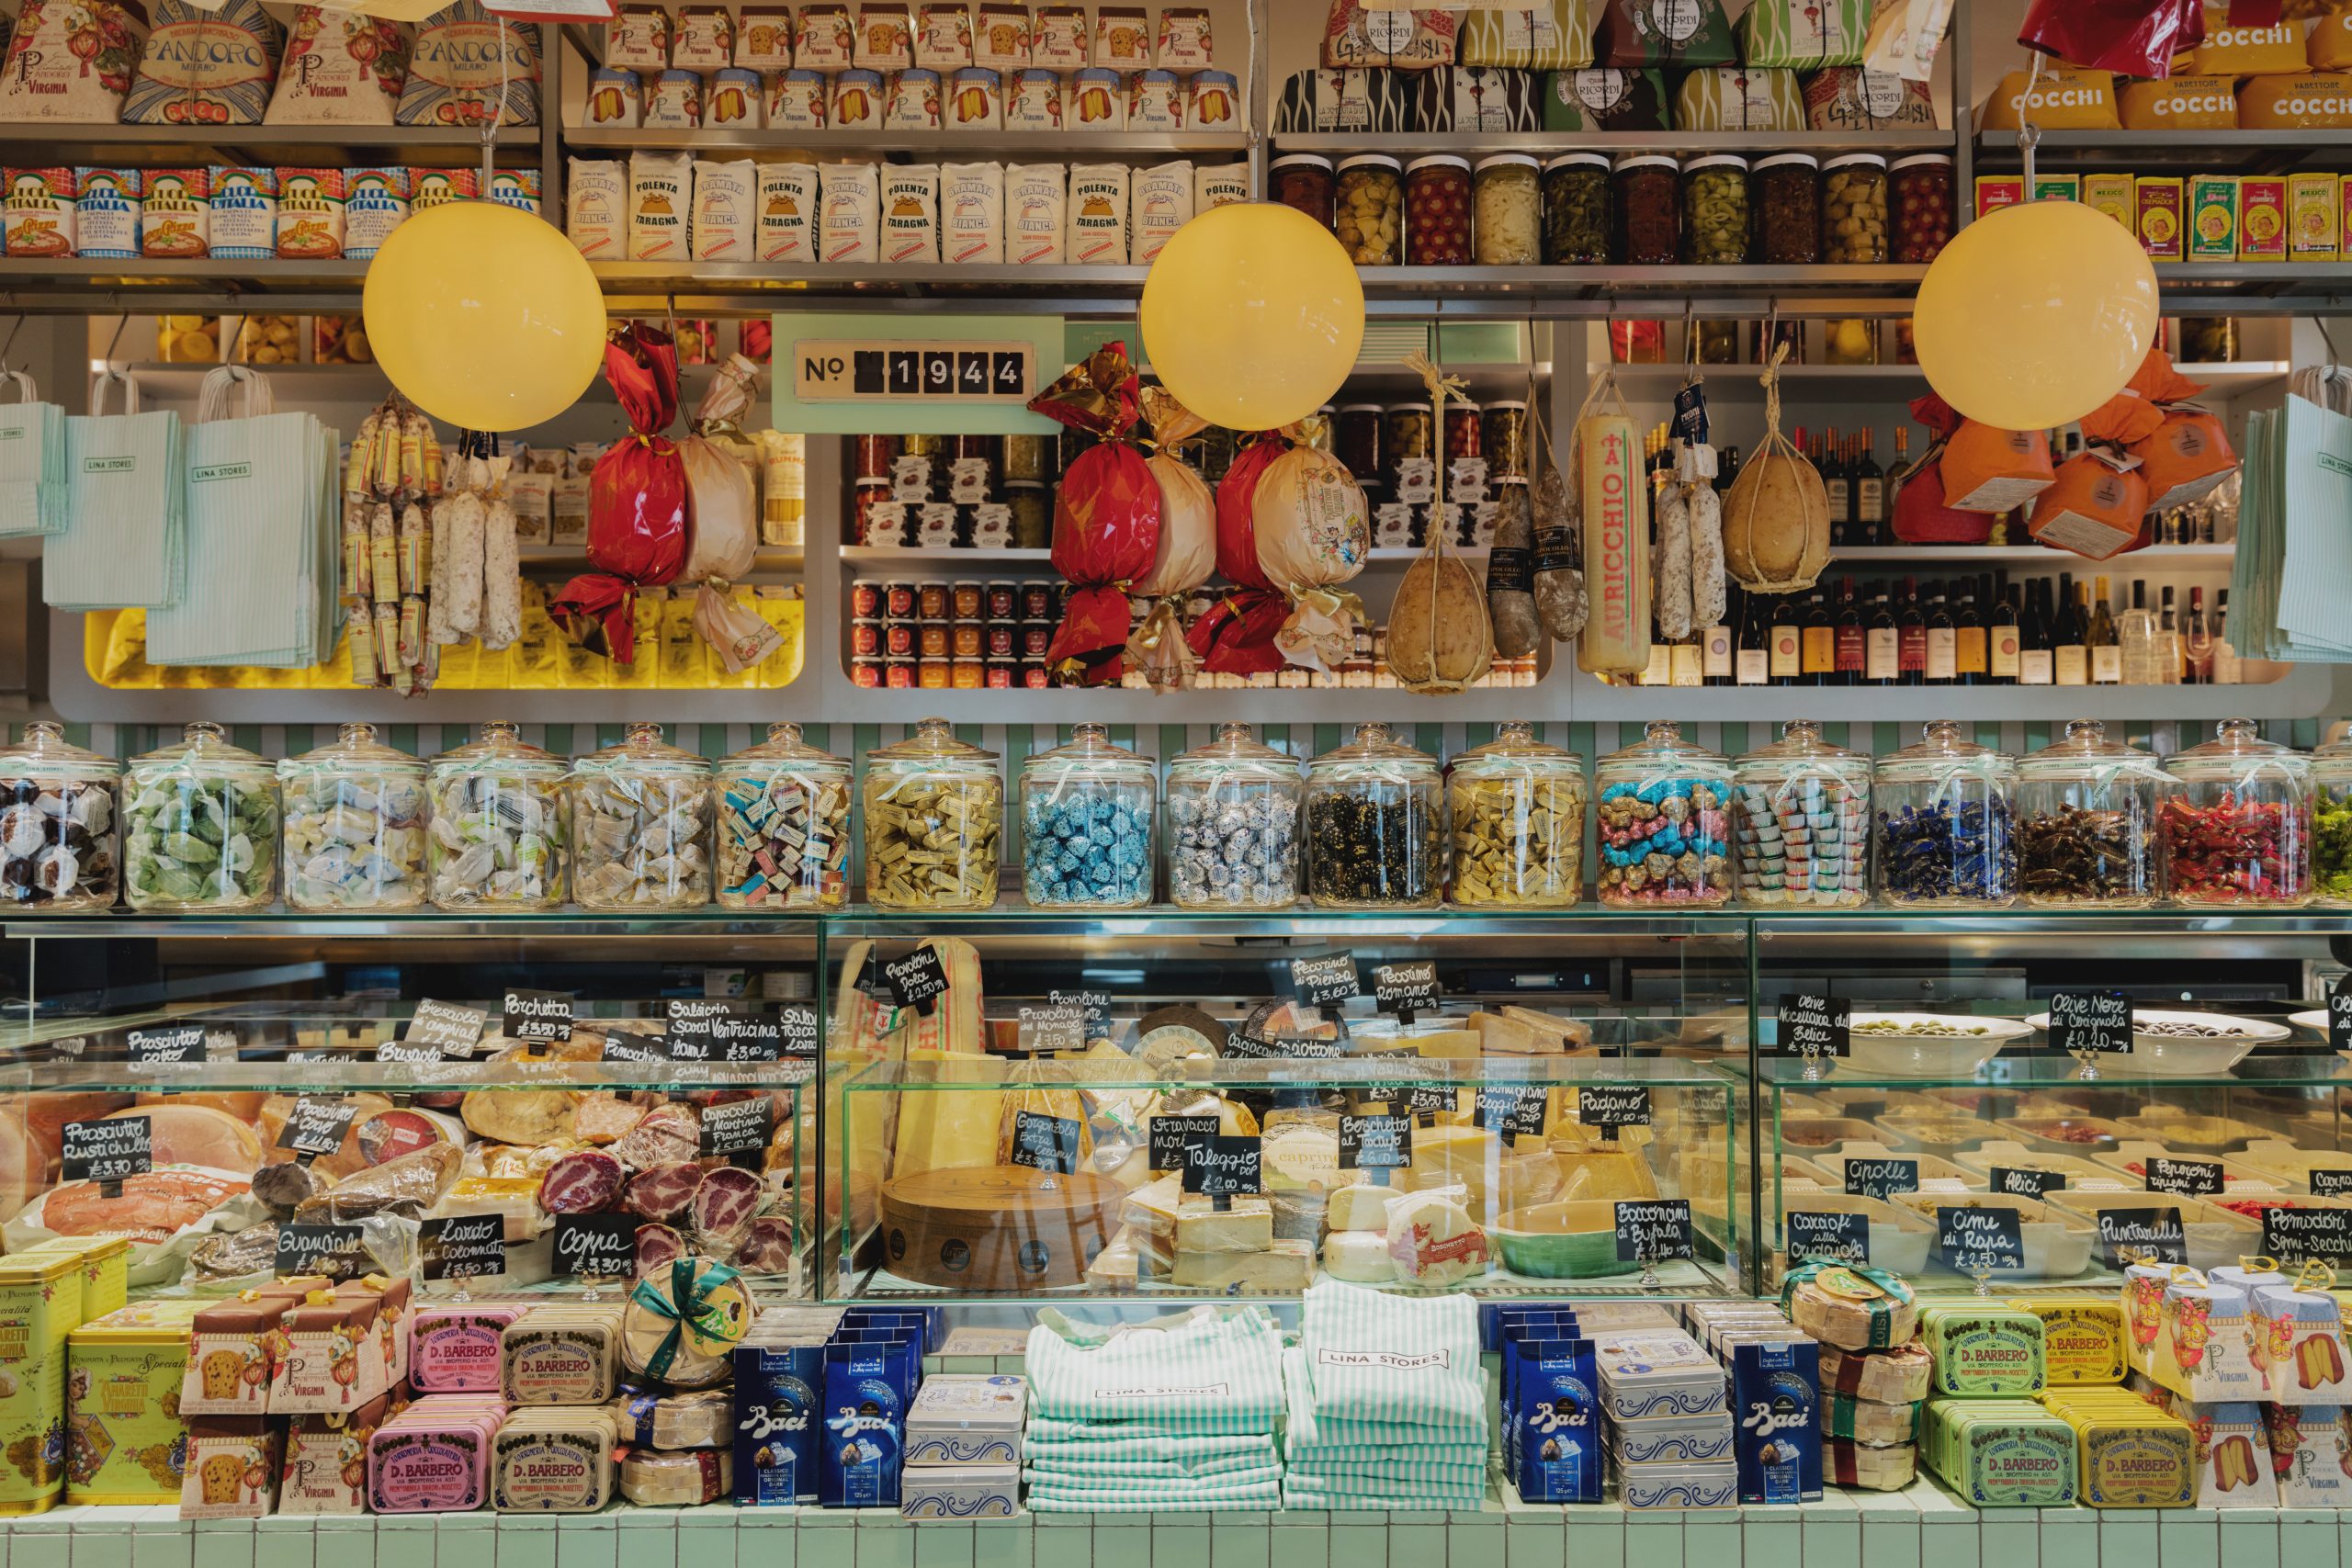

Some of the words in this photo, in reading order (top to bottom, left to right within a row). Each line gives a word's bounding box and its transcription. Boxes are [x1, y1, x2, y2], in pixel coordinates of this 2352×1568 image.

[1370, 28, 1409, 38] RICORDI
[2200, 28, 2292, 50] COCCHI
[142, 39, 263, 68] PANDORO
[414, 39, 533, 67] PANDORO
[453, 62, 487, 72] MILANO
[28, 82, 68, 95] VIRGINIA
[1860, 92, 1901, 103] RICORDI
[2010, 88, 2103, 110] COCCHI
[636, 180, 678, 195] POLENTA
[763, 183, 803, 196] POLENTA
[888, 183, 929, 196] POLENTA
[1078, 184, 1118, 197] POLENTA
[1205, 184, 1247, 197] POLENTA
[2096, 188, 2124, 197] MEXICO
[2300, 188, 2328, 197] MEXICO
[635, 215, 679, 228] TARAGNA
[762, 217, 804, 228] TARAGNA
[887, 217, 930, 229] TARAGNA
[1077, 217, 1119, 229] TARAGNA
[897, 359, 1018, 385] 1944
[88, 461, 107, 469] LINA
[108, 459, 132, 468] STORES
[2322, 456, 2335, 467] LINA
[196, 468, 216, 479] LINA
[219, 465, 248, 476] STORES
[1601, 473, 1625, 642] AURICCHIO
[886, 949, 936, 978] Provolone
[1292, 953, 1351, 976] Pecorino
[899, 971, 929, 993] Dolce
[1295, 976, 1306, 987] di
[1306, 969, 1356, 987] Pienza
[1377, 964, 1432, 985] Pecorino
[1376, 982, 1435, 1001] Romano
[504, 993, 574, 1020] Porchetta
[1798, 995, 1826, 1011] Olive
[2052, 993, 2089, 1013] Olive
[1020, 1007, 1084, 1022] Provolone
[1779, 1006, 1832, 1028] Nocellara
[1834, 1013, 1850, 1029] del
[2050, 1014, 2064, 1027] di
[711, 1016, 781, 1040] Ventricina
[1792, 1025, 1832, 1043] Belice
[127, 1029, 202, 1052] Prosciutto
[701, 1099, 769, 1121] Capocollo
[1476, 1095, 1543, 1115] Reggiano
[1579, 1091, 1646, 1111] Padano
[701, 1122, 711, 1134] di
[713, 1113, 765, 1132] Martina
[1016, 1113, 1077, 1140] Gorgonzola
[1341, 1115, 1410, 1134] Boschetto
[1520, 1112, 1542, 1123] DOP
[64, 1118, 145, 1142] Prosciutto
[713, 1126, 760, 1144] Franca
[1019, 1131, 1052, 1145] Extra
[62, 1136, 152, 1159] Rustichello
[1340, 1134, 1356, 1146] al
[1356, 1133, 1403, 1152] Tartufo
[1185, 1144, 1261, 1172] Taleggio
[1239, 1165, 1259, 1177] DOP
[1849, 1160, 1910, 1181] Cipolle
[2156, 1158, 2216, 1179] Peperoni
[2005, 1170, 2042, 1193] Alici
[1617, 1202, 1689, 1223] Bocconcini
[1952, 1210, 2000, 1231] Cime
[2268, 1208, 2348, 1231] Pomodori
[437, 1218, 497, 1244] Lardo
[1793, 1212, 1852, 1234] Carciofi
[2100, 1215, 2183, 1242] Puntarelle
[277, 1230, 361, 1255] Guanciale
[558, 1226, 634, 1255] Coppa
[1617, 1225, 1629, 1241] di
[1631, 1224, 1681, 1244] Bufala
[1942, 1231, 1958, 1247] di
[1964, 1230, 2015, 1250] Rapa
[424, 1248, 436, 1261] di
[442, 1238, 506, 1260] Colonnata
[430, 1345, 442, 1358] D.
[443, 1345, 497, 1358] BARBERO
[2055, 1337, 2109, 1350] BARBERO
[1329, 1354, 1370, 1363] LINA
[1379, 1353, 1441, 1367] STORES
[1961, 1349, 1974, 1362] D.
[1975, 1349, 2029, 1363] BARBERO
[521, 1360, 534, 1373] D.
[536, 1359, 591, 1372] BARBERO
[2217, 1370, 2249, 1382] VIRGINIA
[293, 1385, 326, 1397] VIRGINIA
[739, 1405, 809, 1439] Baci
[830, 1406, 893, 1438] Baci
[1529, 1402, 1589, 1434] Baci
[1742, 1403, 1809, 1437] Baci
[390, 1465, 404, 1478] D.
[405, 1463, 463, 1477] BARBERO
[513, 1464, 526, 1478] D.
[527, 1464, 585, 1477] BARBERO
[1988, 1458, 2002, 1471] D.
[2004, 1458, 2059, 1472] BARBERO
[2106, 1460, 2120, 1472] D.
[2120, 1459, 2177, 1472] BARBERO
[2308, 1476, 2340, 1489] VIRGINIA
[304, 1486, 335, 1499] VIRGINIA
